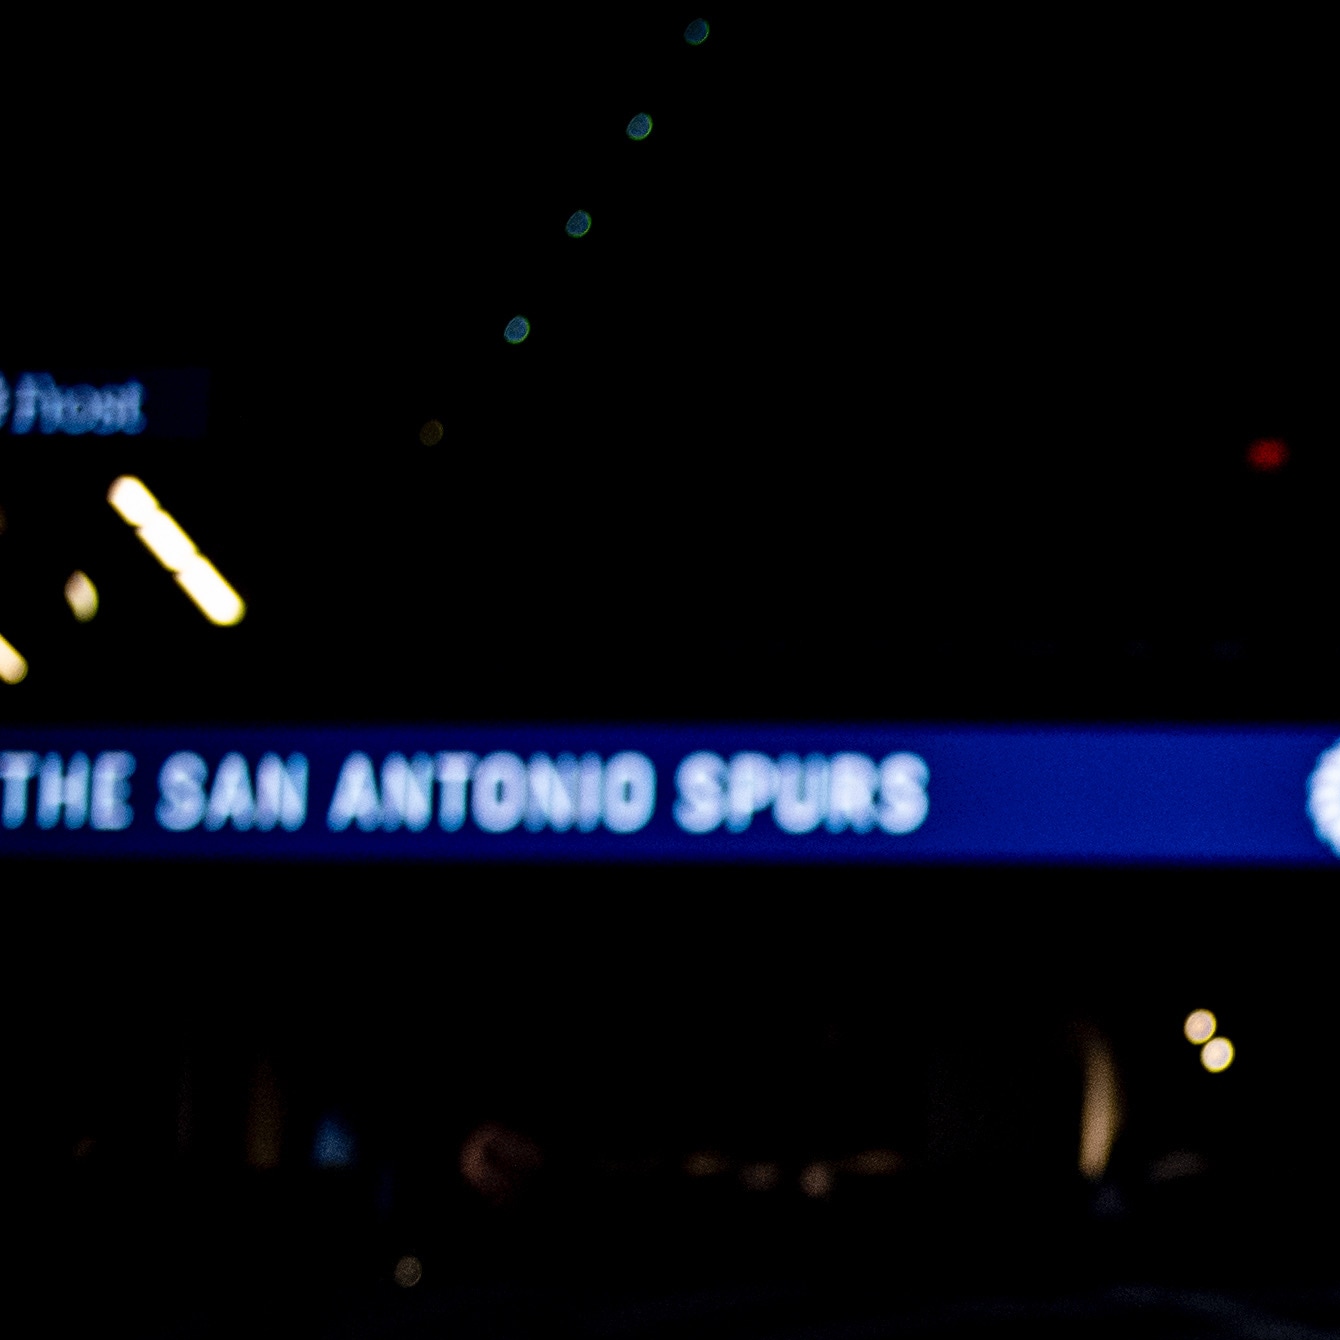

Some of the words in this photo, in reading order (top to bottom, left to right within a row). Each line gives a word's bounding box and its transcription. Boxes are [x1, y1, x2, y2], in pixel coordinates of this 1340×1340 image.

[0, 750, 136, 832] THE
[156, 750, 310, 832] SAN
[326, 749, 656, 834] ANTONIO
[673, 749, 930, 835] SPURS
